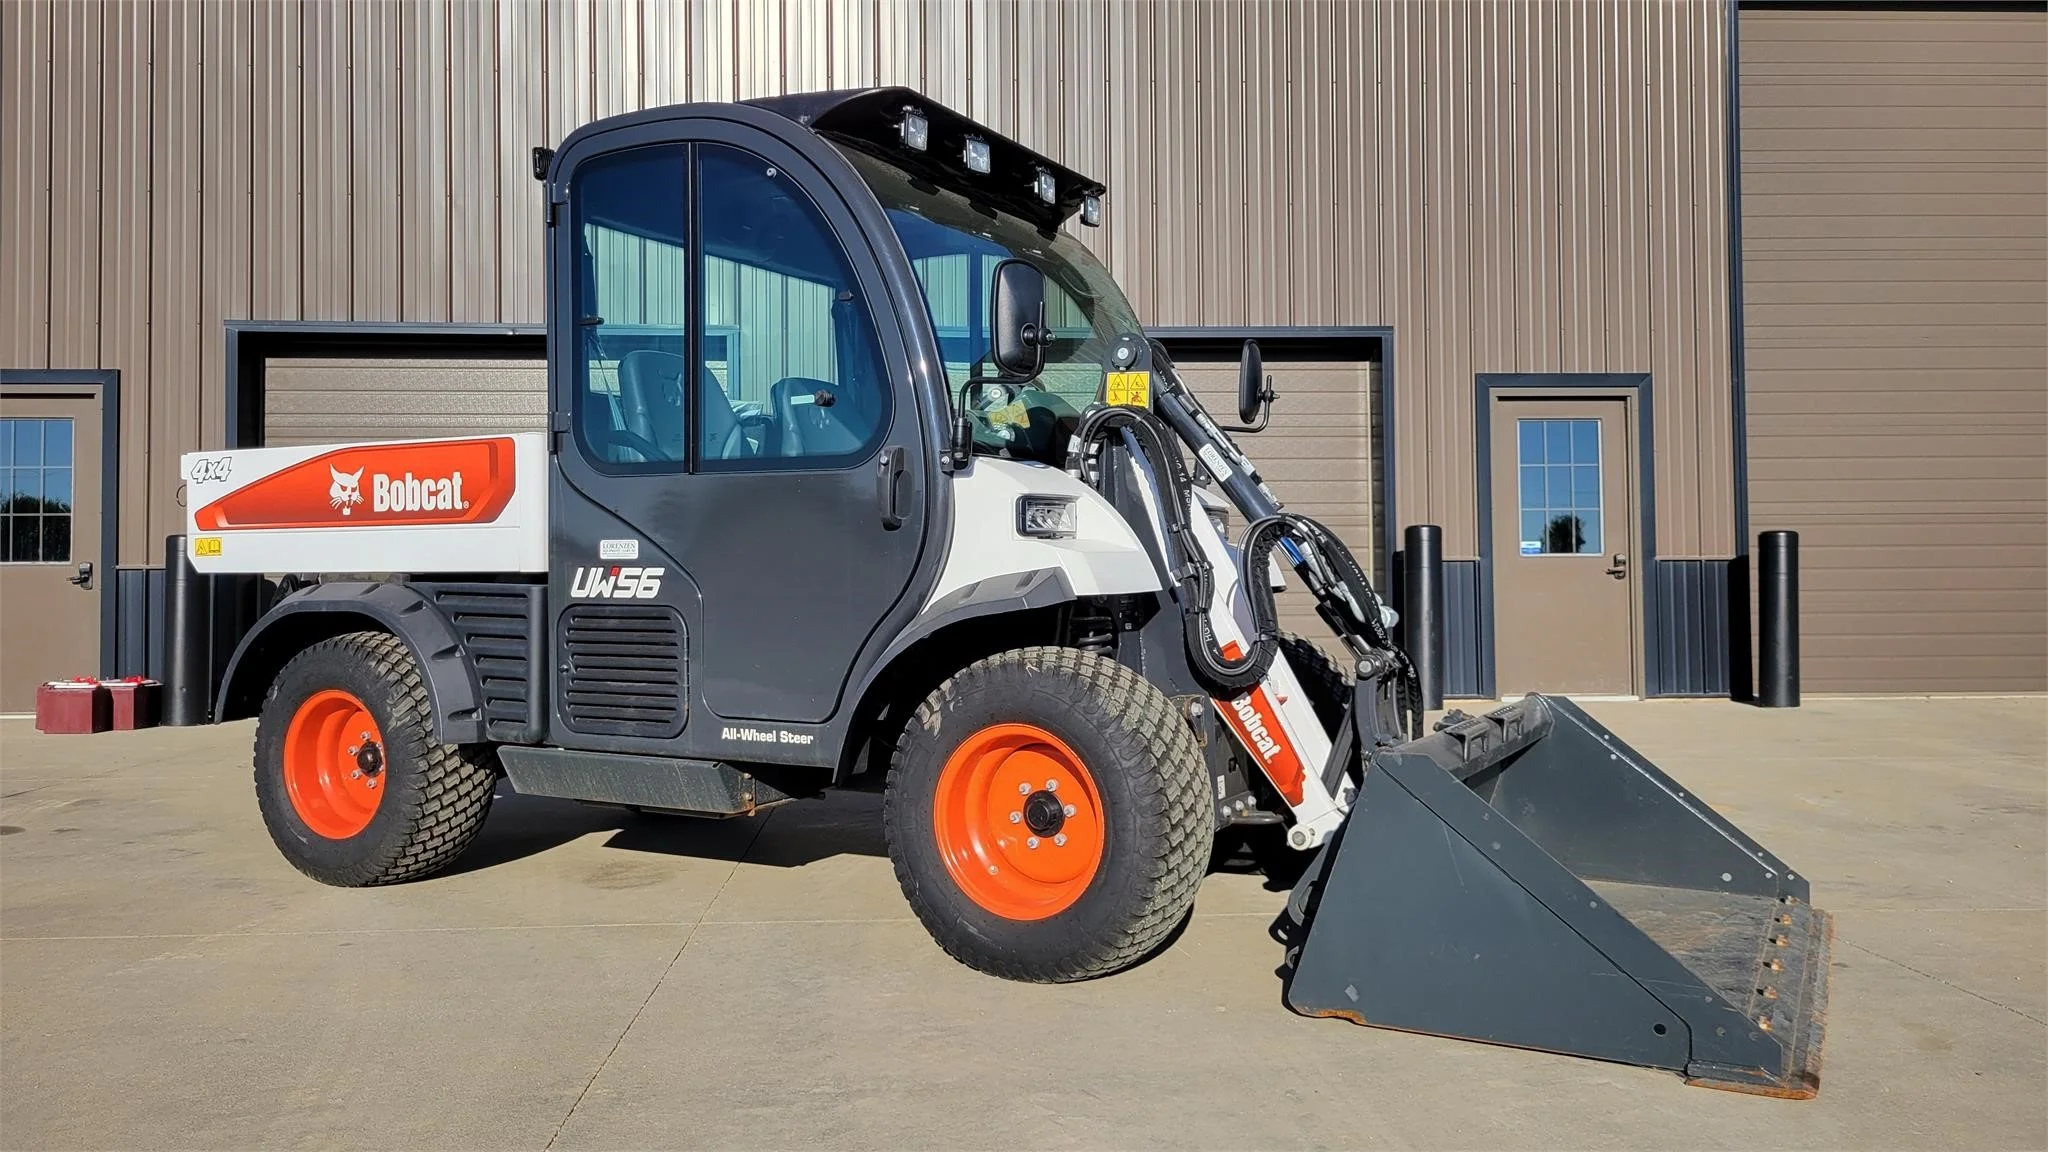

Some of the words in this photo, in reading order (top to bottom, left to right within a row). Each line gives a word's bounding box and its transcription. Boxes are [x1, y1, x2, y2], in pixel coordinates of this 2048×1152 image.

[190, 456, 233, 484] 4x4
[372, 471, 464, 512] Bobcat
[570, 566, 665, 598] UW56
[721, 727, 777, 743] All-Wheel
[780, 730, 814, 745] Steer
[1231, 691, 1281, 760] Bobcat
